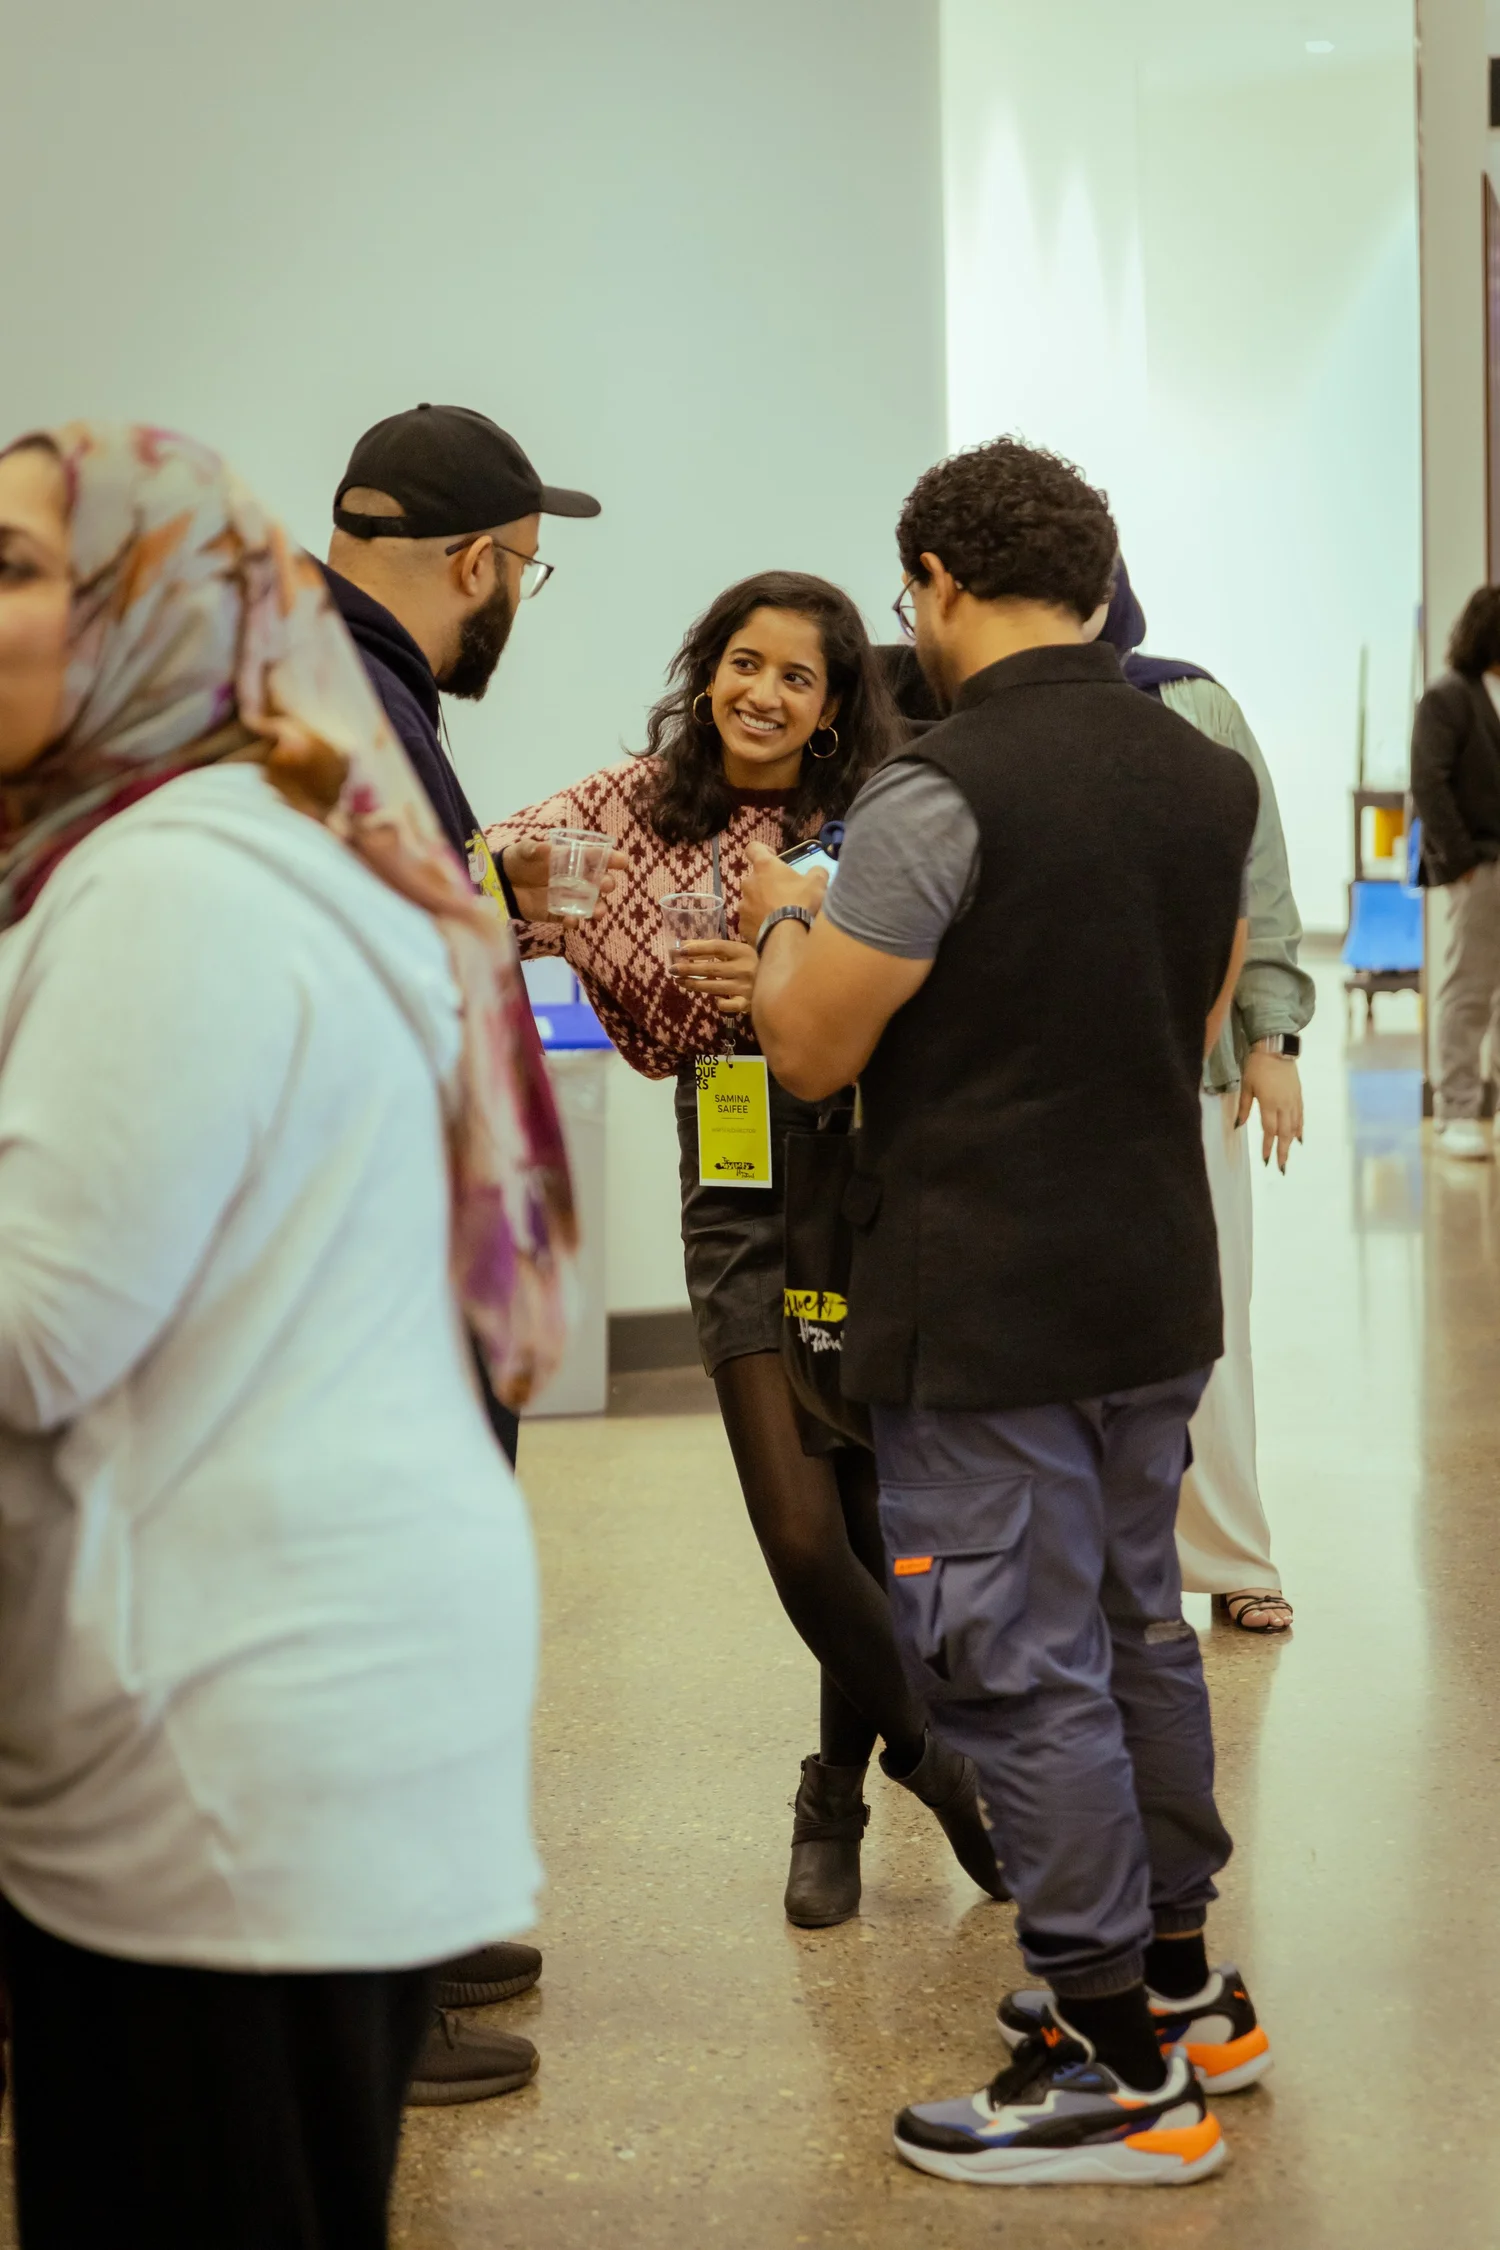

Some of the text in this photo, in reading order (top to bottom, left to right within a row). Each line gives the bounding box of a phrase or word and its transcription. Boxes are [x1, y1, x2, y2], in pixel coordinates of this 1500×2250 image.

[695, 1054, 718, 1066] MOS
[695, 1067, 716, 1078] QUE
[714, 1094, 750, 1103] SAMINA
[717, 1105, 748, 1113] SAIFEE
